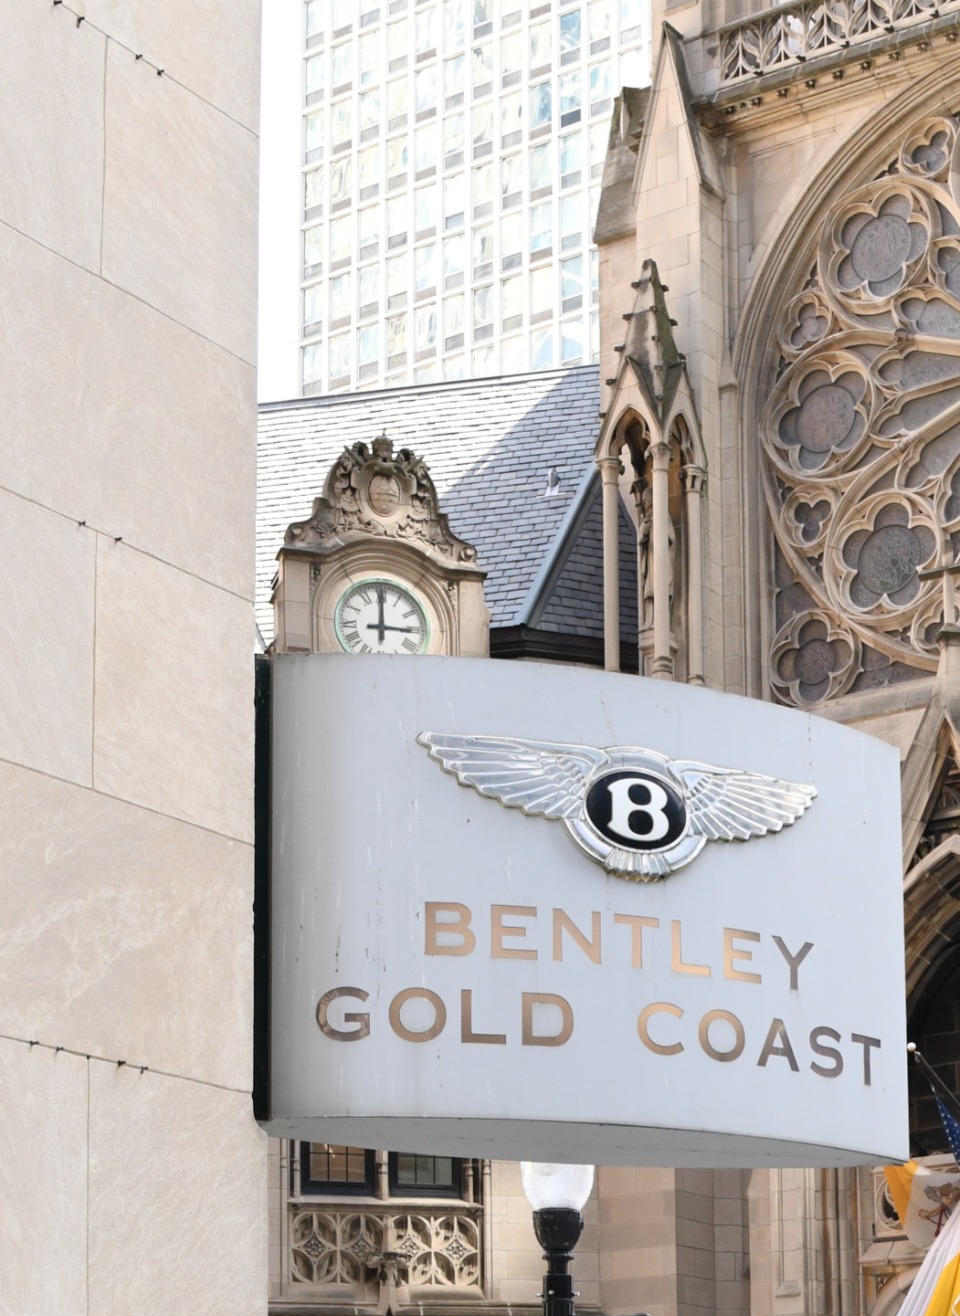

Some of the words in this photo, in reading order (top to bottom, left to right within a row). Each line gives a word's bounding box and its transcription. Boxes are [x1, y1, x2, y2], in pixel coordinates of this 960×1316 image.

[605, 776, 669, 841] B
[424, 901, 814, 990] BENTLEY
[315, 986, 574, 1046] GOLD
[636, 1001, 881, 1086] COAST
